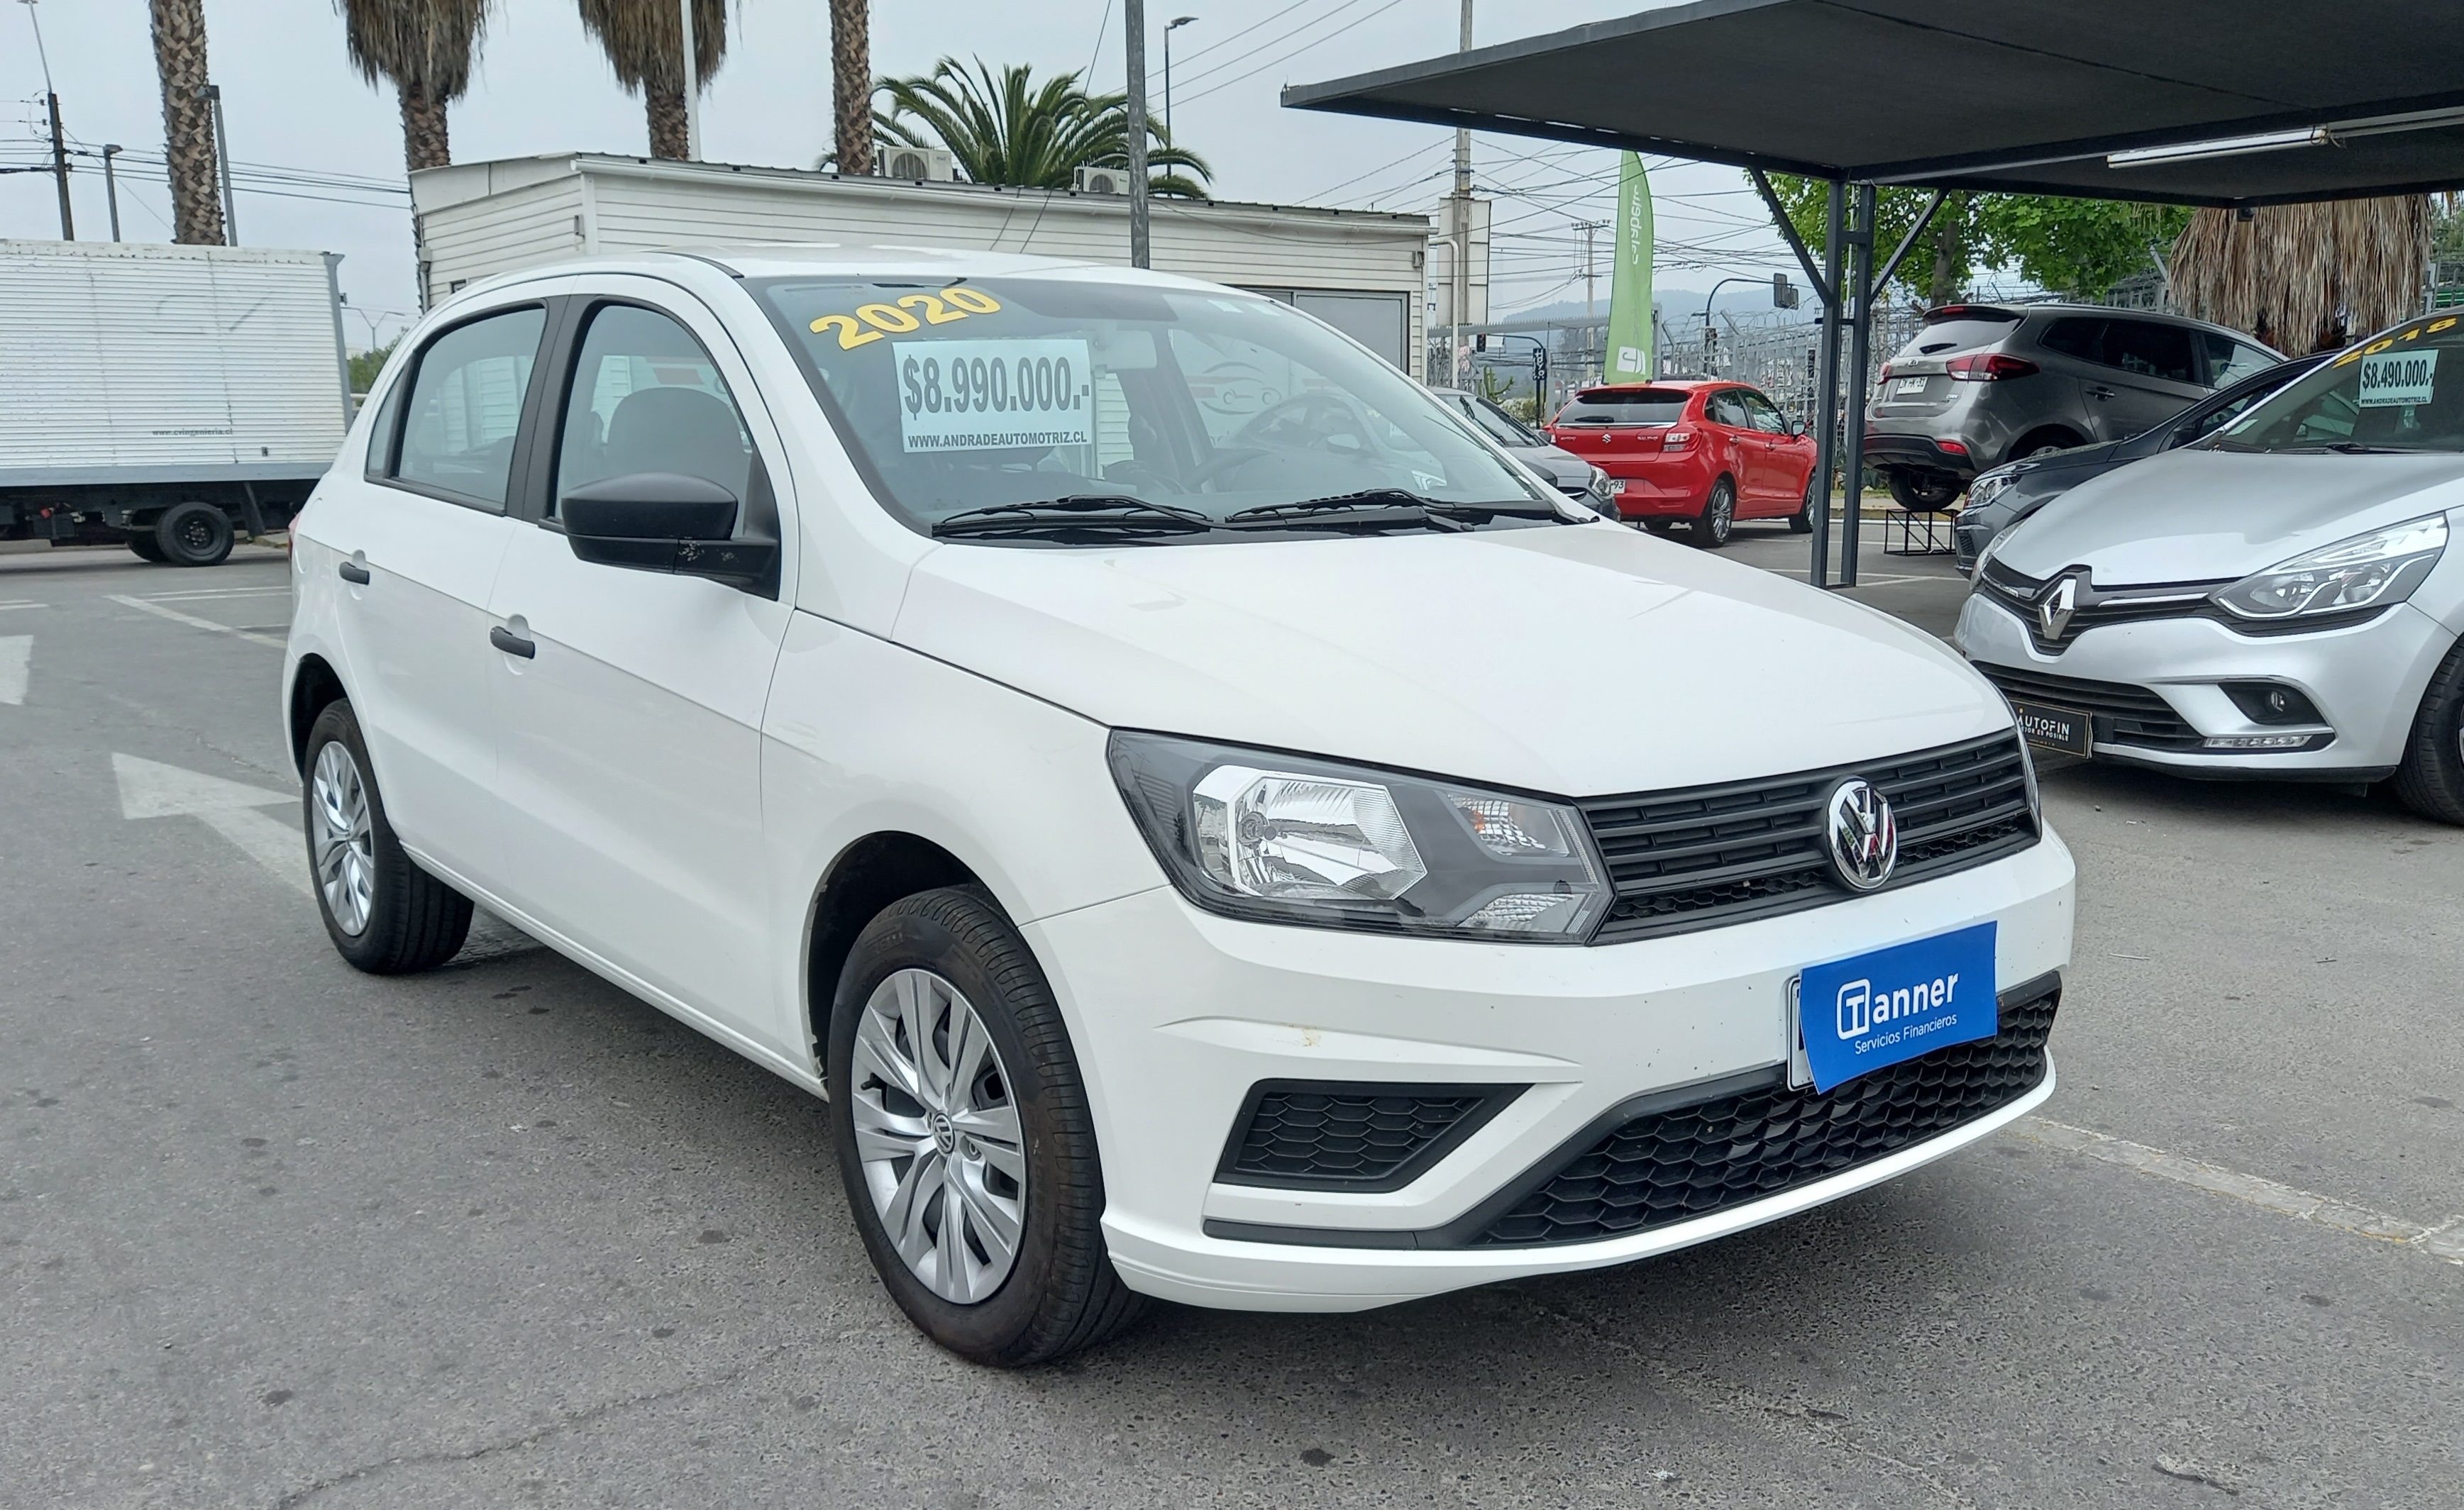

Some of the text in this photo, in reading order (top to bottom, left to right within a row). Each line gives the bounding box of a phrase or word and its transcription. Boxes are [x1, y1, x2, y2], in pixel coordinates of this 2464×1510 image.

[810, 287, 1001, 350] 2020
[2331, 317, 2458, 370] 2018
[902, 354, 1090, 421] $8.990.000.-
[2362, 359, 2433, 392] $8.490.000.-
[2360, 396, 2428, 405] WWW.ANDRADEAUTOMOTRIZ.CL
[907, 431, 1088, 448] WWW.ANDRADEAUTOMOTRIZ.CL
[2018, 714, 2070, 735] AUTOFIN
[2045, 731, 2069, 742] POSIBLE
[1836, 972, 1959, 1040] Tanner
[1855, 1014, 1957, 1055] Servicios Financieros
